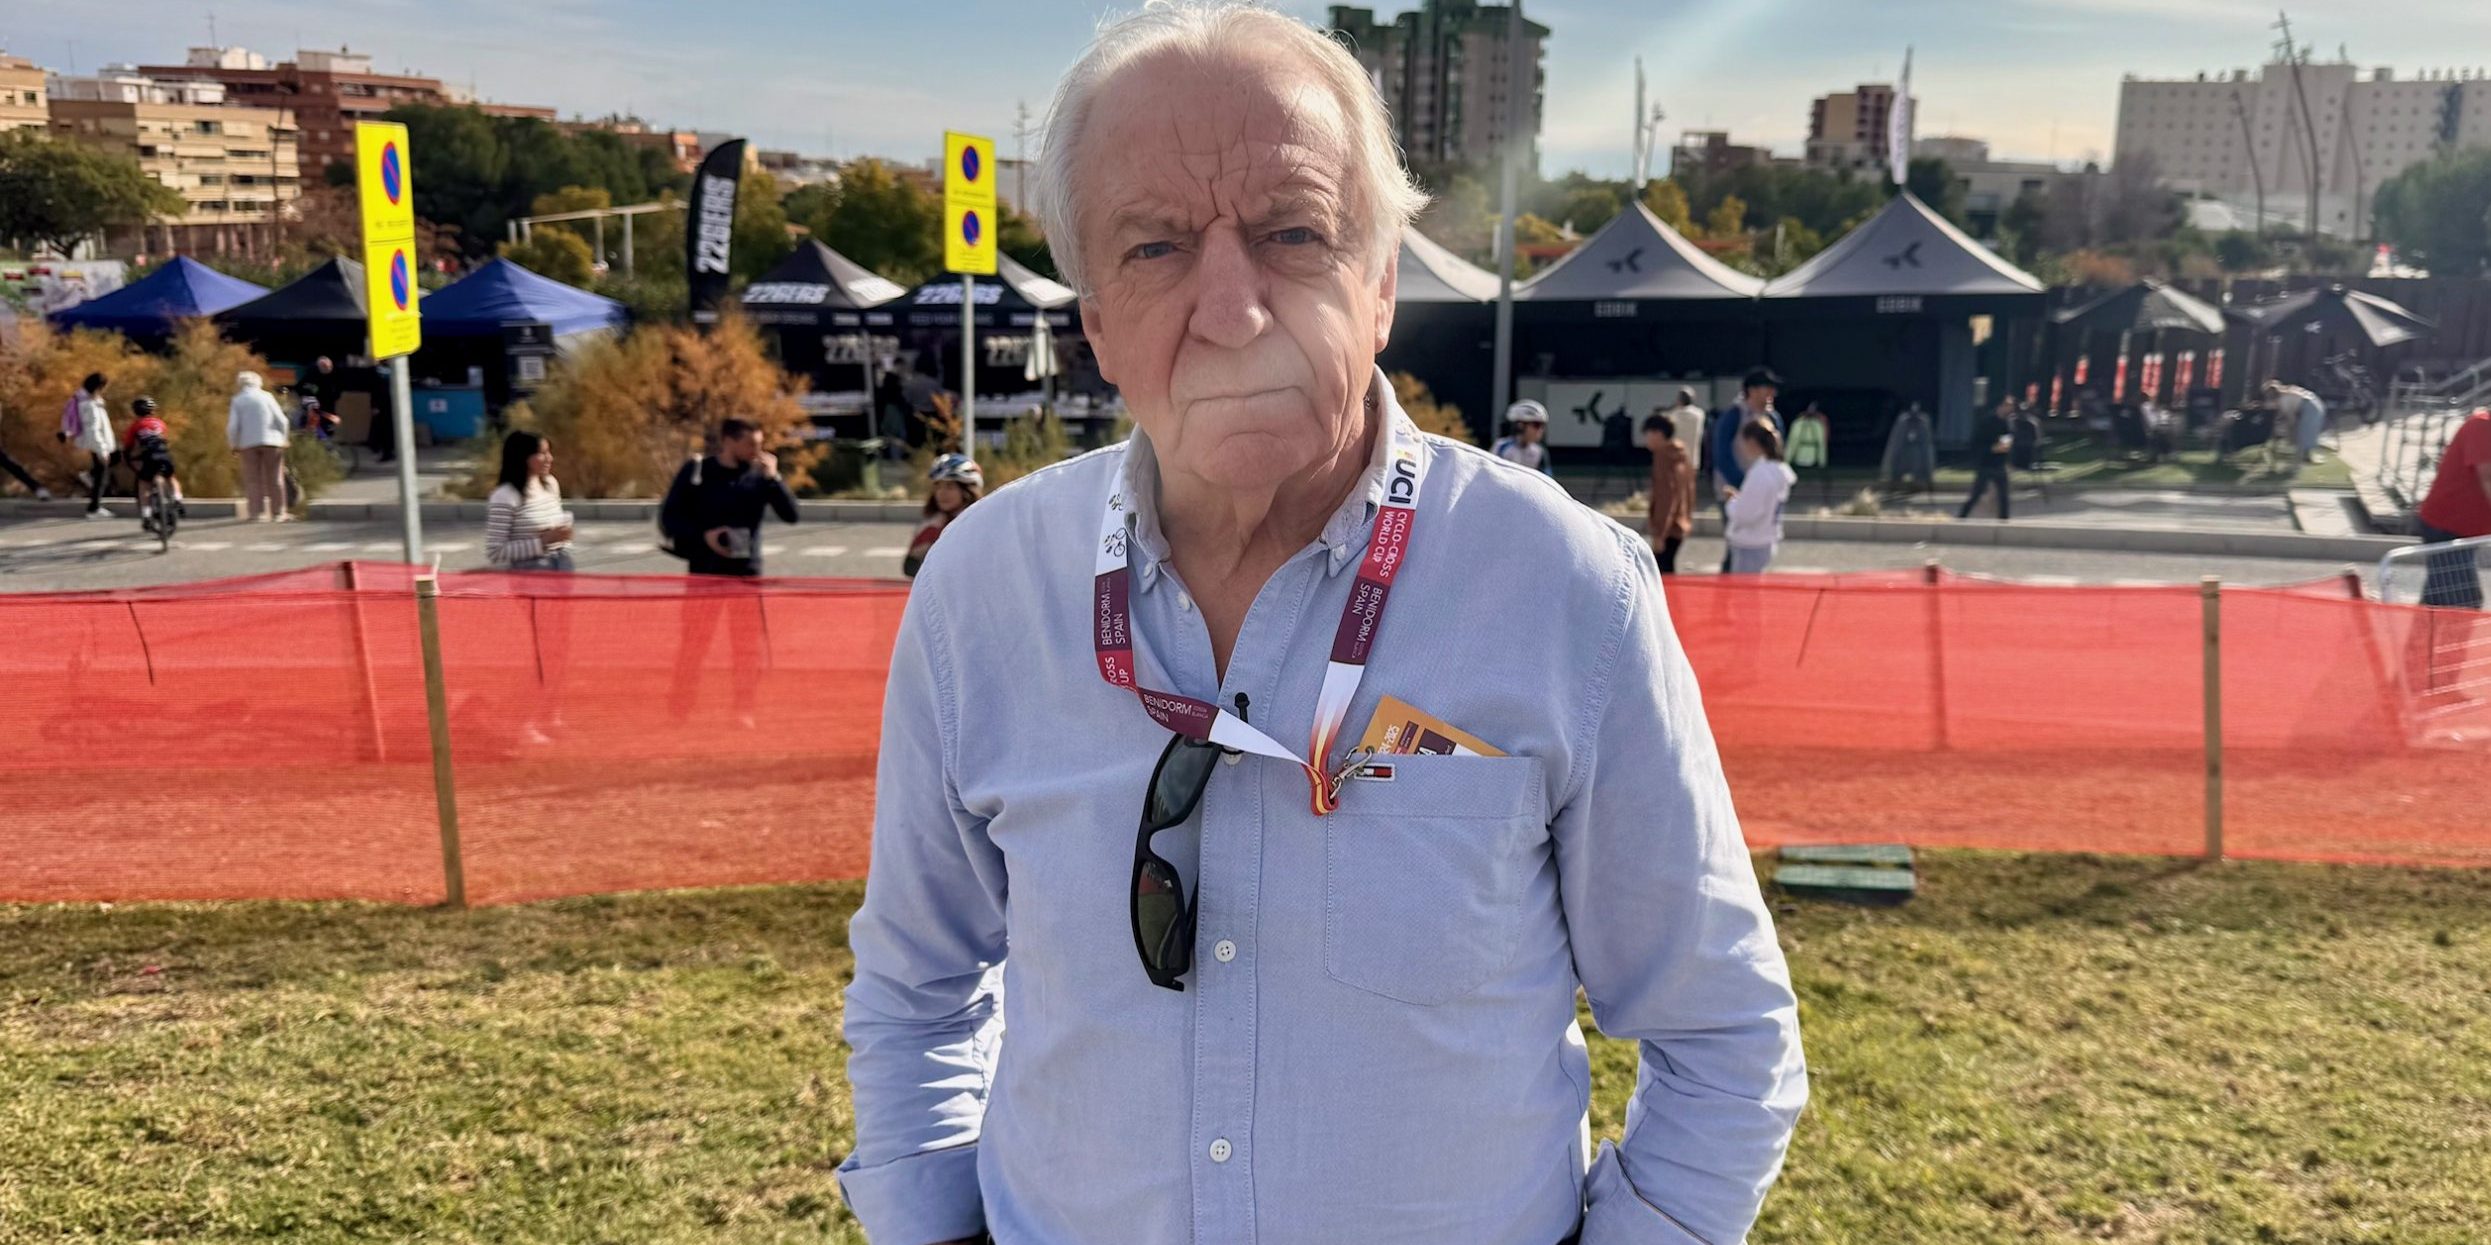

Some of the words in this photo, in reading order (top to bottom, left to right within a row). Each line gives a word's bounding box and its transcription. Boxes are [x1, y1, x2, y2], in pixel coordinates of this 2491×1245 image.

[913, 283, 1004, 304] 226RS
[1389, 458, 1416, 504] UCI
[1378, 511, 1395, 545] WORLD
[1373, 546, 1384, 563] CUP
[1379, 512, 1408, 578] CYCLO-CROSS
[1352, 583, 1370, 615] SPAIN
[1357, 588, 1382, 641] BENIDORM
[1101, 593, 1112, 645] BENIDORM
[1114, 613, 1126, 644] SPAIN
[1119, 669, 1130, 683] UP
[1144, 694, 1193, 715] BENIDORM
[1147, 705, 1169, 722] SPAIN
